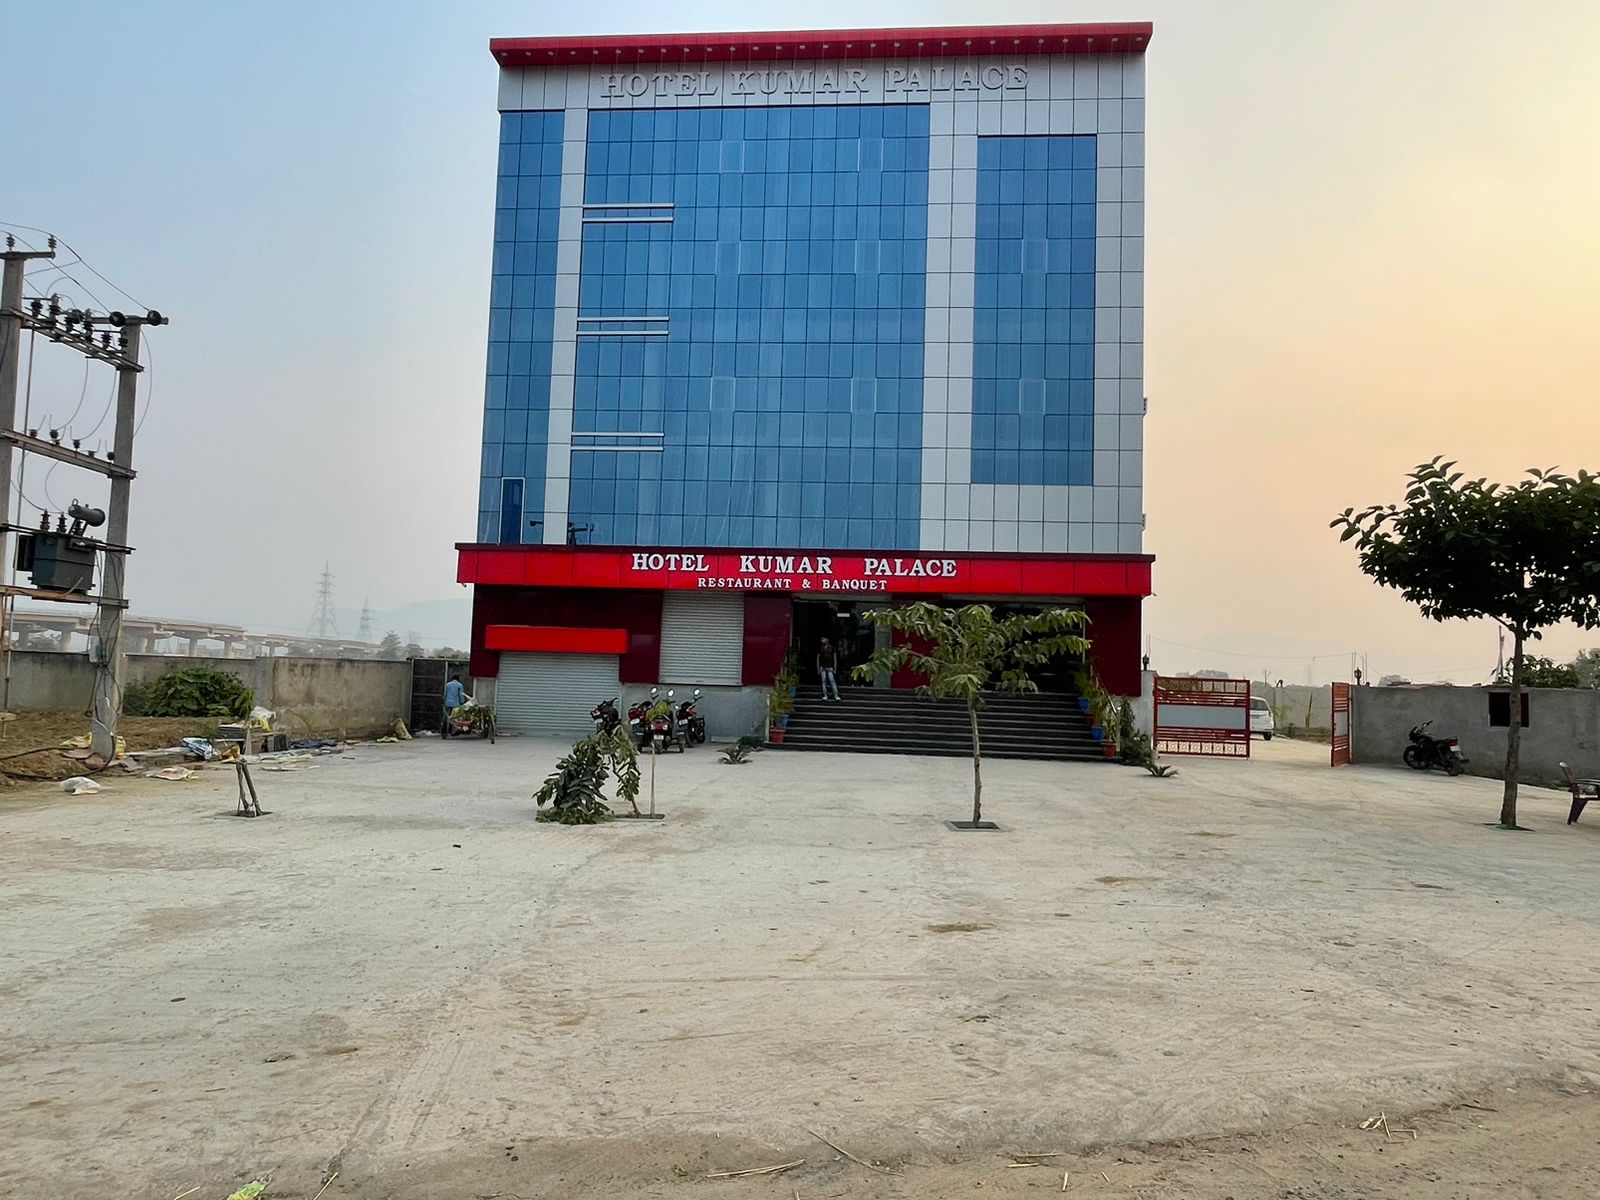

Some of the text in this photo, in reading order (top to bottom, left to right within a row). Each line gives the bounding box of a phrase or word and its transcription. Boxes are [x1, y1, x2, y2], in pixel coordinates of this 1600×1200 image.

[599, 65, 1029, 98] HOTEL KUMAR PALACE
[631, 552, 958, 578] HOTEL KUMAR PALACE
[697, 578, 888, 592] RESTAURANT & BANQUET
